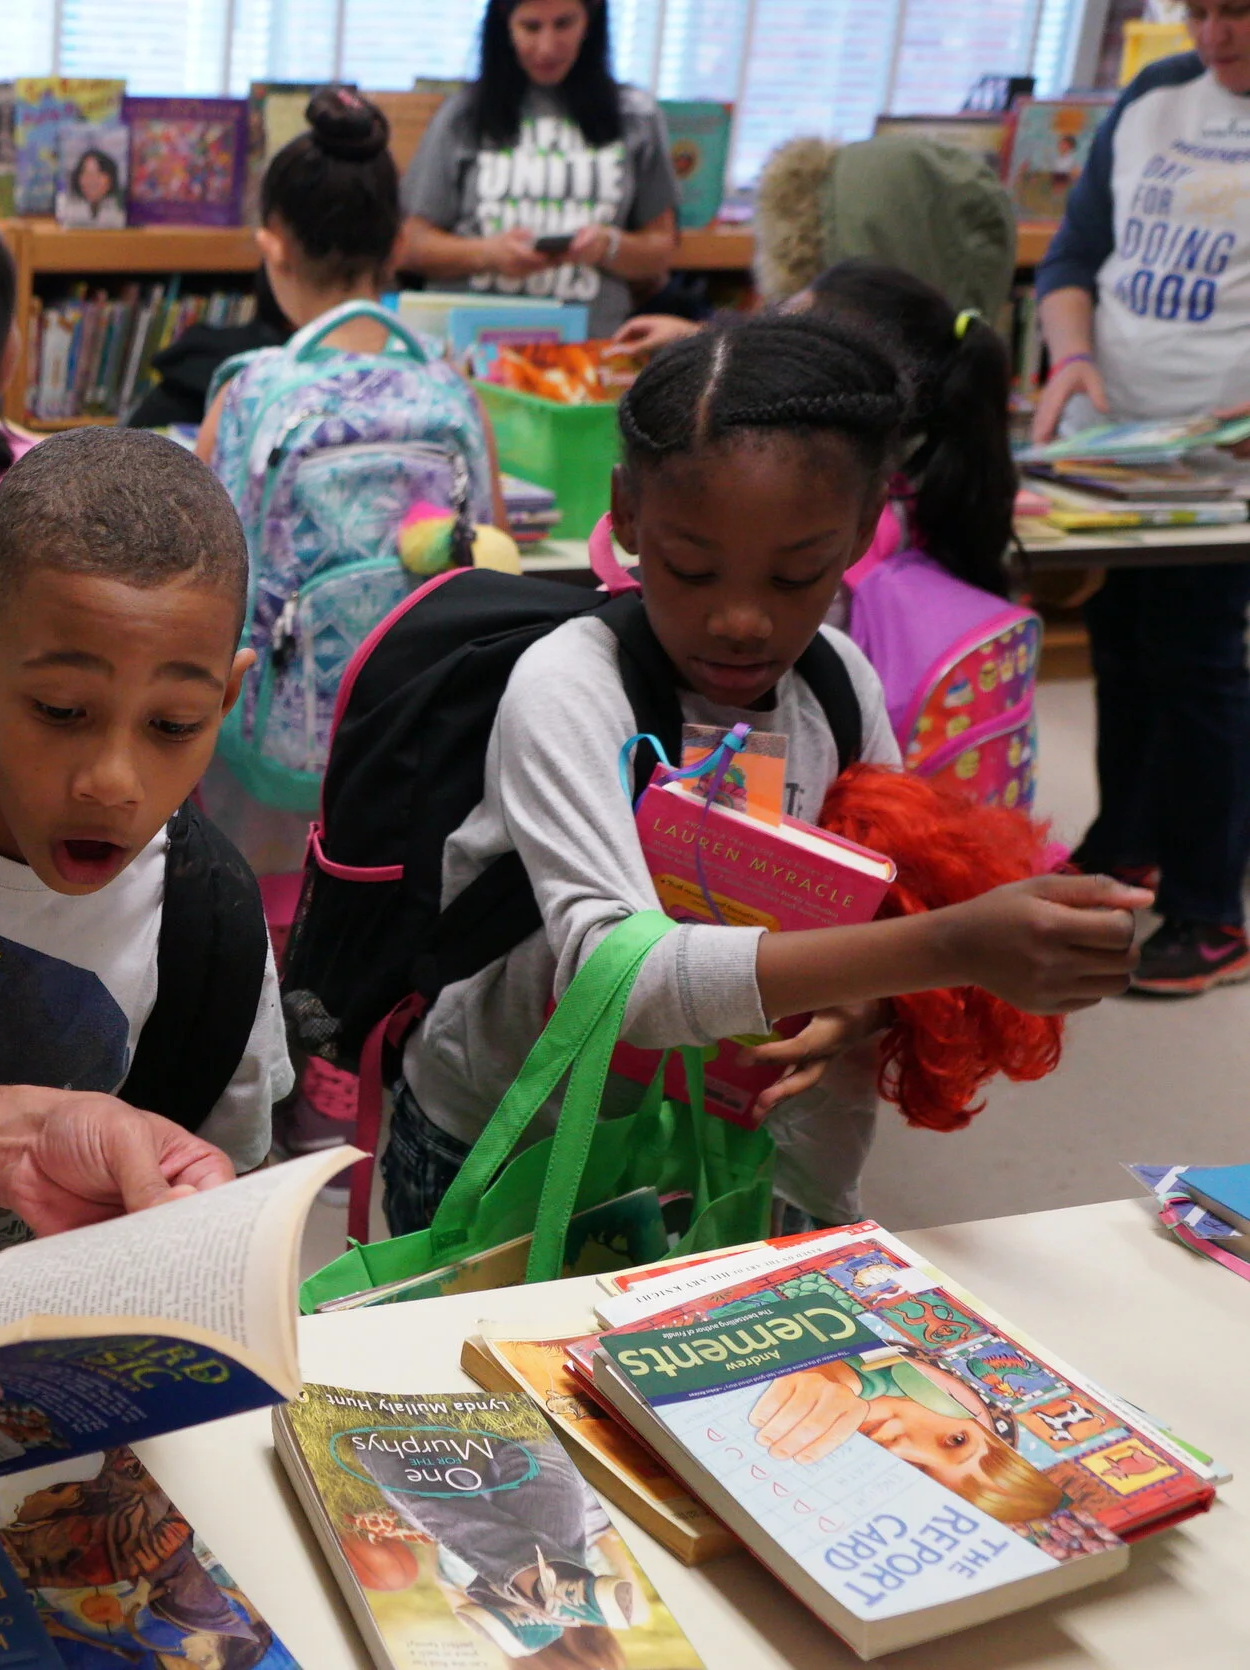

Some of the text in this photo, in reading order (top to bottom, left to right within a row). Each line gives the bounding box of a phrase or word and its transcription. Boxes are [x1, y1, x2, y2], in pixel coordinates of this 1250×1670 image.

[477, 147, 624, 200] UNITE
[1130, 182, 1175, 217] FOR
[1118, 216, 1237, 277] DOING
[653, 817, 741, 861] LAUREN
[749, 856, 855, 909] MYRACLE
[635, 1286, 684, 1304] KNIGHT
[662, 1308, 775, 1339] The bestselling author of Frindle
[617, 1307, 857, 1377] Clements
[725, 1349, 781, 1372] Andrew
[326, 1394, 510, 1416] Lynda Mullaly Hunt
[352, 1433, 494, 1461] Murphys
[409, 1456, 463, 1466] FOR THE
[404, 1467, 482, 1491] One
[824, 1514, 908, 1571] CARD
[843, 1504, 980, 1607] REPORT
[948, 1538, 1010, 1579] THE
